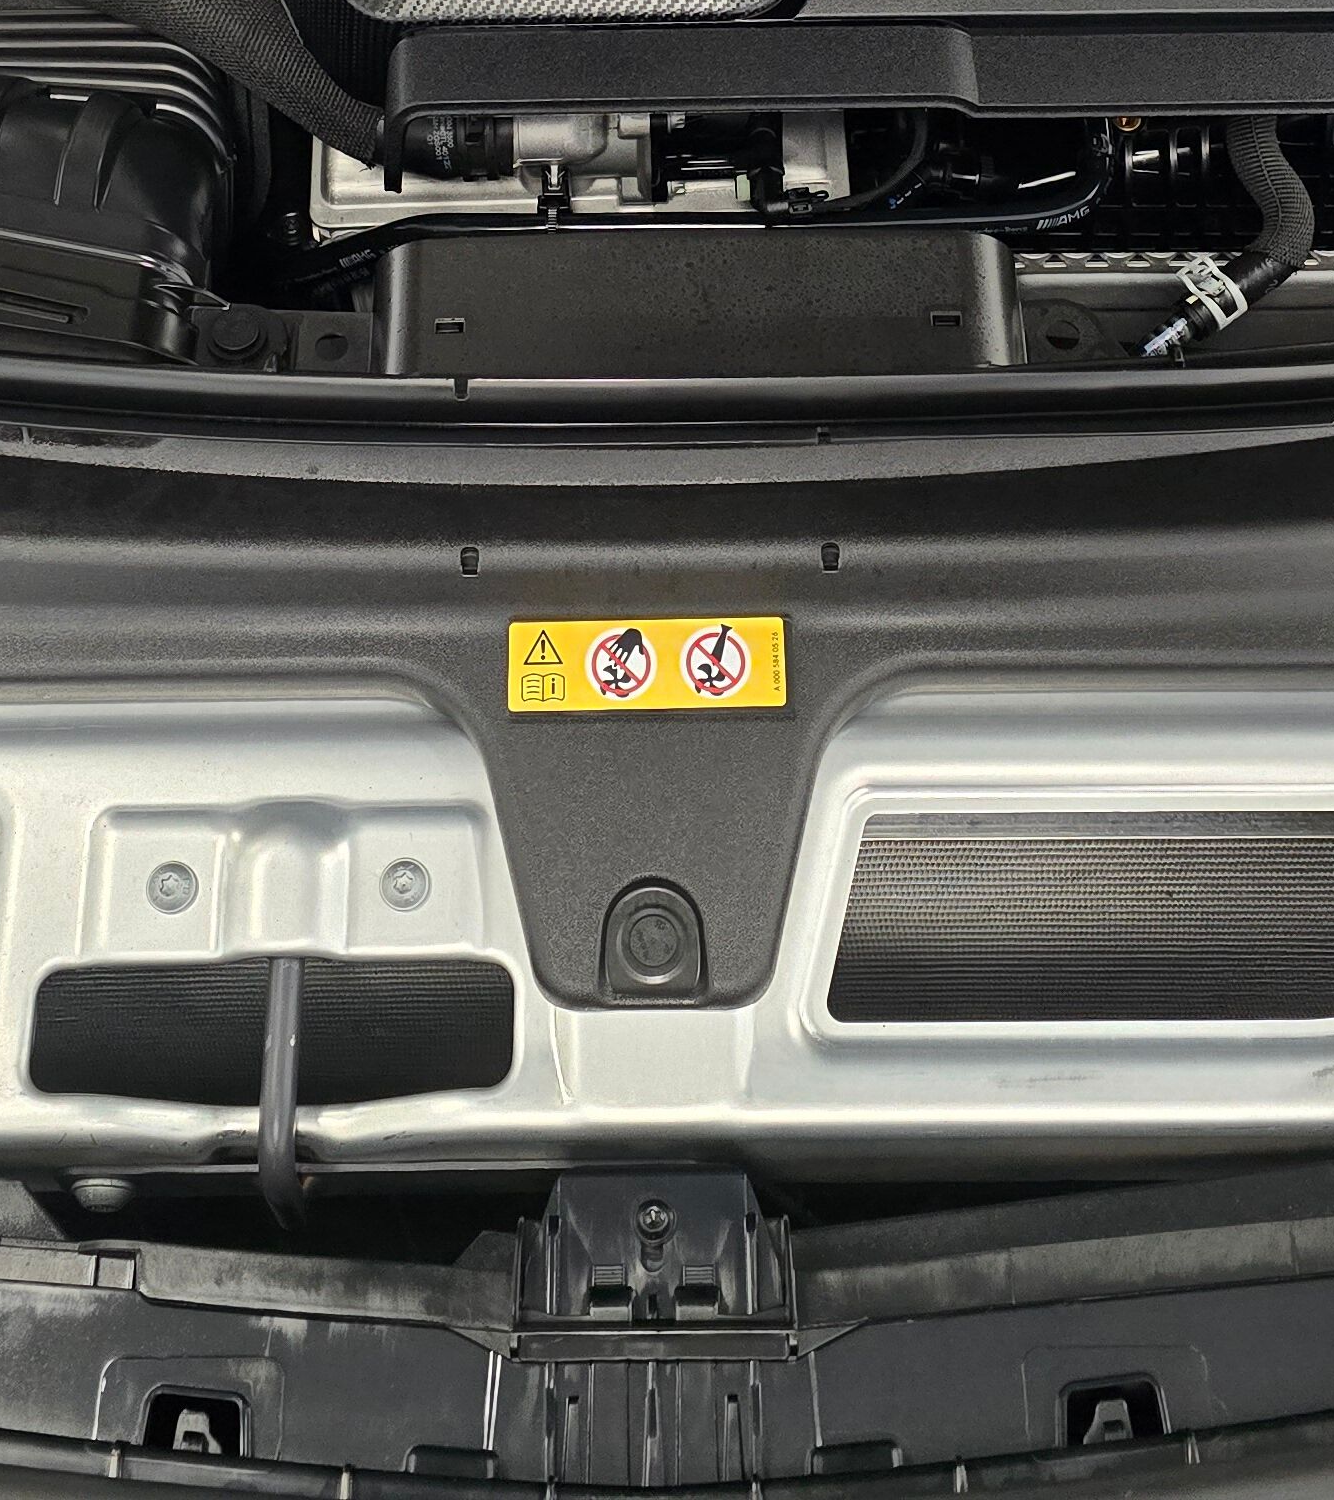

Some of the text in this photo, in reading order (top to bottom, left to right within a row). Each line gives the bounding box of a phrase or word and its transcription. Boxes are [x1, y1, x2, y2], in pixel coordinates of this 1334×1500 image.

[772, 631, 780, 642] 26
[772, 642, 780, 652] 05
[772, 652, 780, 668] 584
[772, 667, 781, 685] 000
